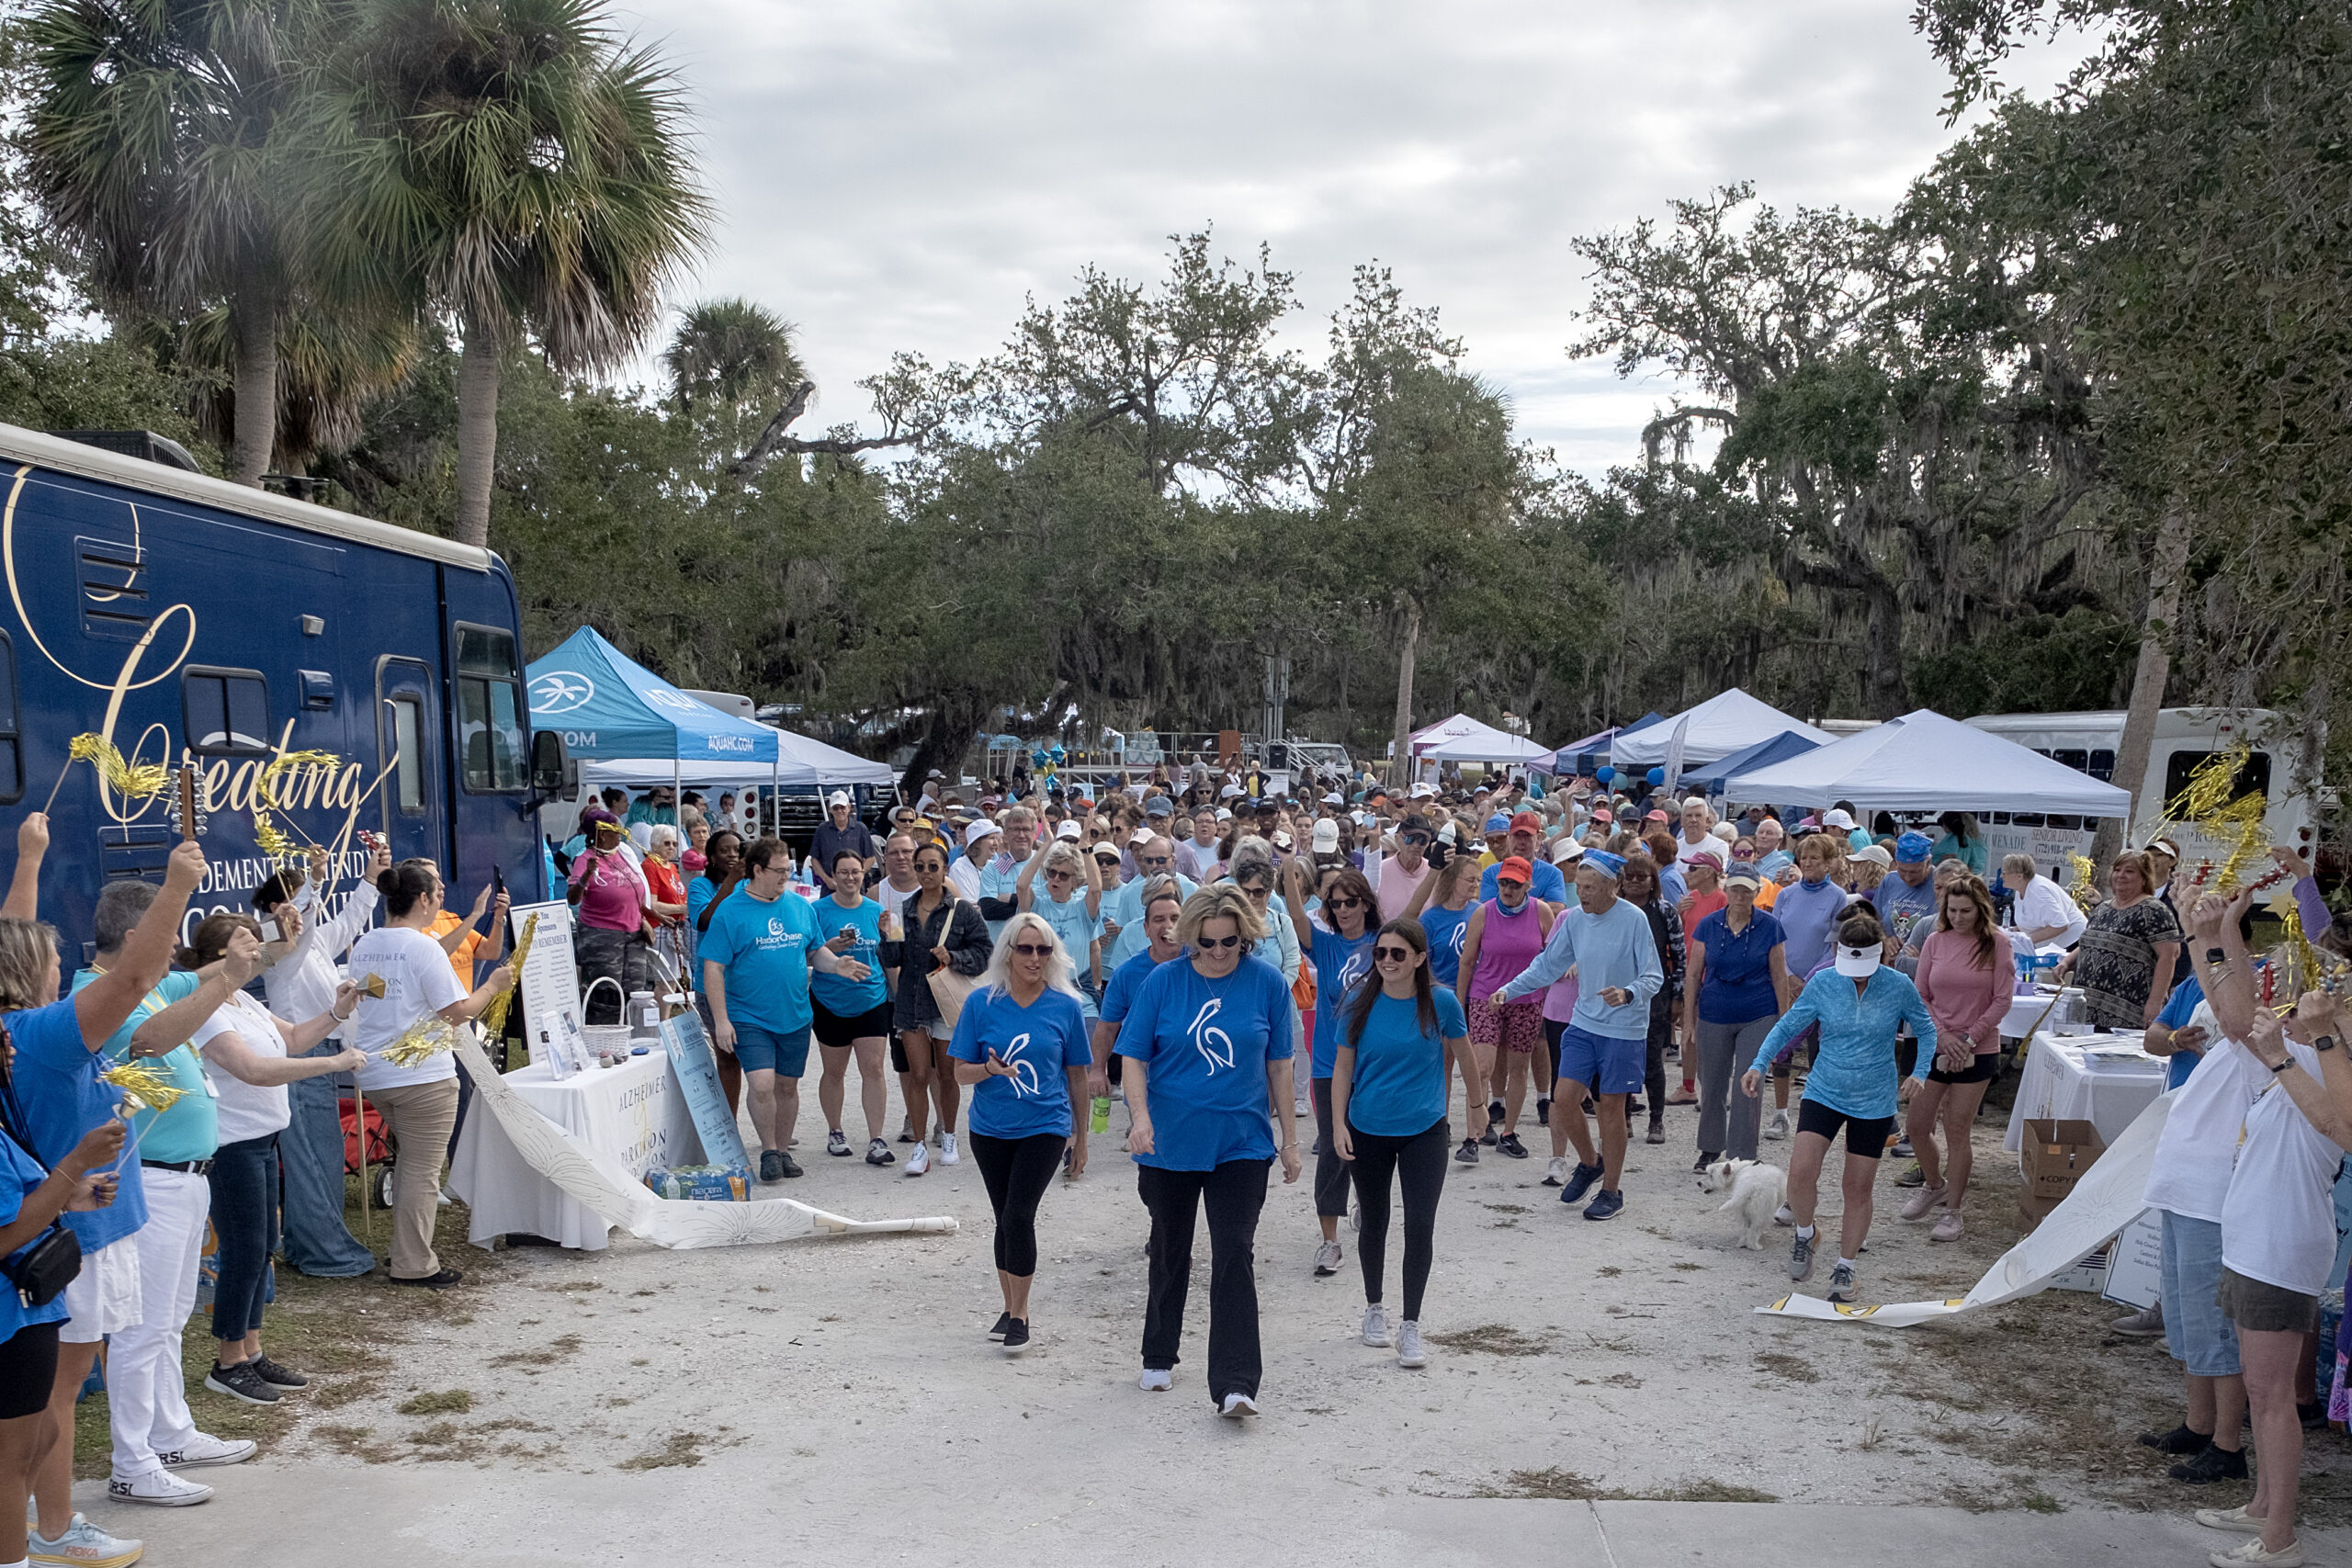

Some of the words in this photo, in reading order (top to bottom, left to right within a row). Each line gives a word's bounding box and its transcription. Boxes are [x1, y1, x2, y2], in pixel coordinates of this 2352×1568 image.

[707, 735, 754, 753] AQUAHC.COM
[755, 932, 803, 945] HarborChase
[618, 1075, 667, 1112] ALZHEIMER
[2046, 1176, 2071, 1184] COPY
[691, 1186, 722, 1197] niagara
[63, 1545, 98, 1558] HOKA
